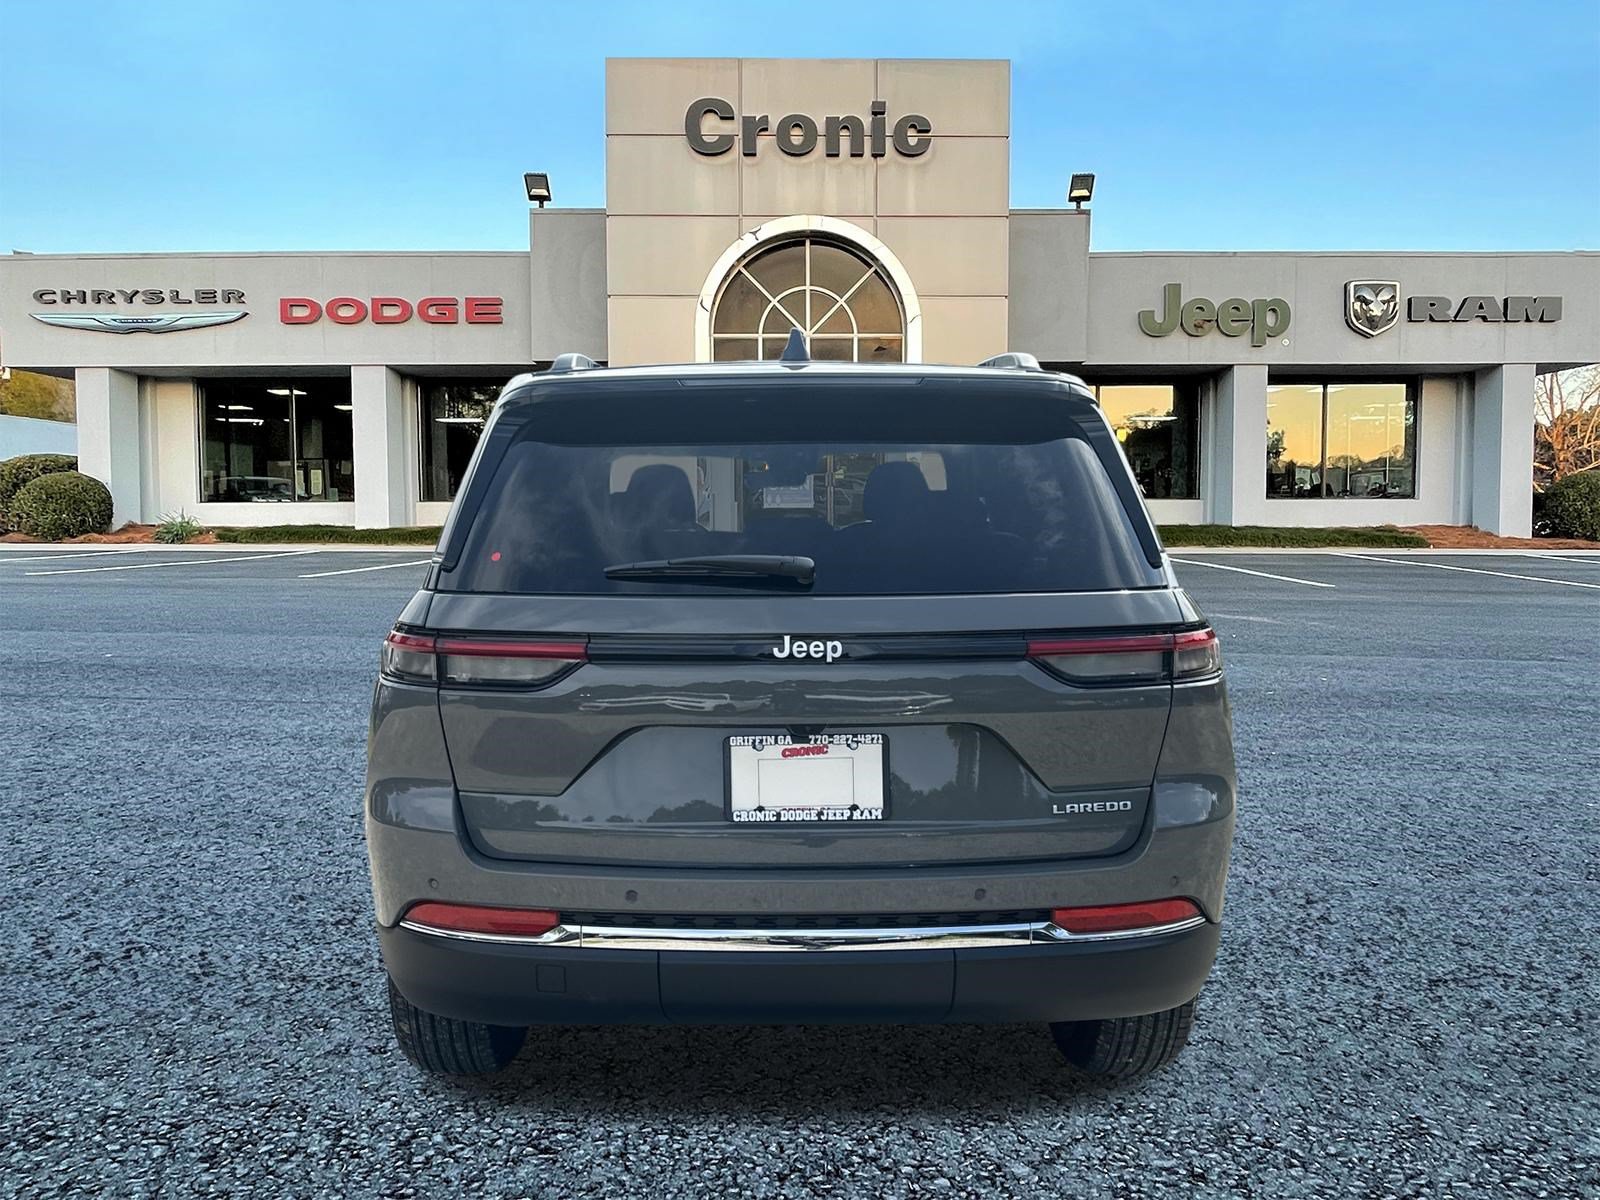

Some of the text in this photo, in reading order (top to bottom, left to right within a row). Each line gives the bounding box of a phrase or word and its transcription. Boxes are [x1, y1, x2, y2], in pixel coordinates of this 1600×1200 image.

[684, 97, 932, 157] Cronic
[32, 288, 246, 305] CHRYSLER
[279, 297, 504, 325] DODGE
[1138, 283, 1292, 348] Jeep
[1407, 296, 1563, 323] RAM
[772, 635, 843, 663] Jeep
[729, 734, 883, 746] GRIFFIN GA 770-227-4271
[781, 744, 830, 758] CRONIC
[733, 808, 883, 822] CRONIC DODGE JEEP RAM
[1052, 800, 1132, 814] LAREDO
